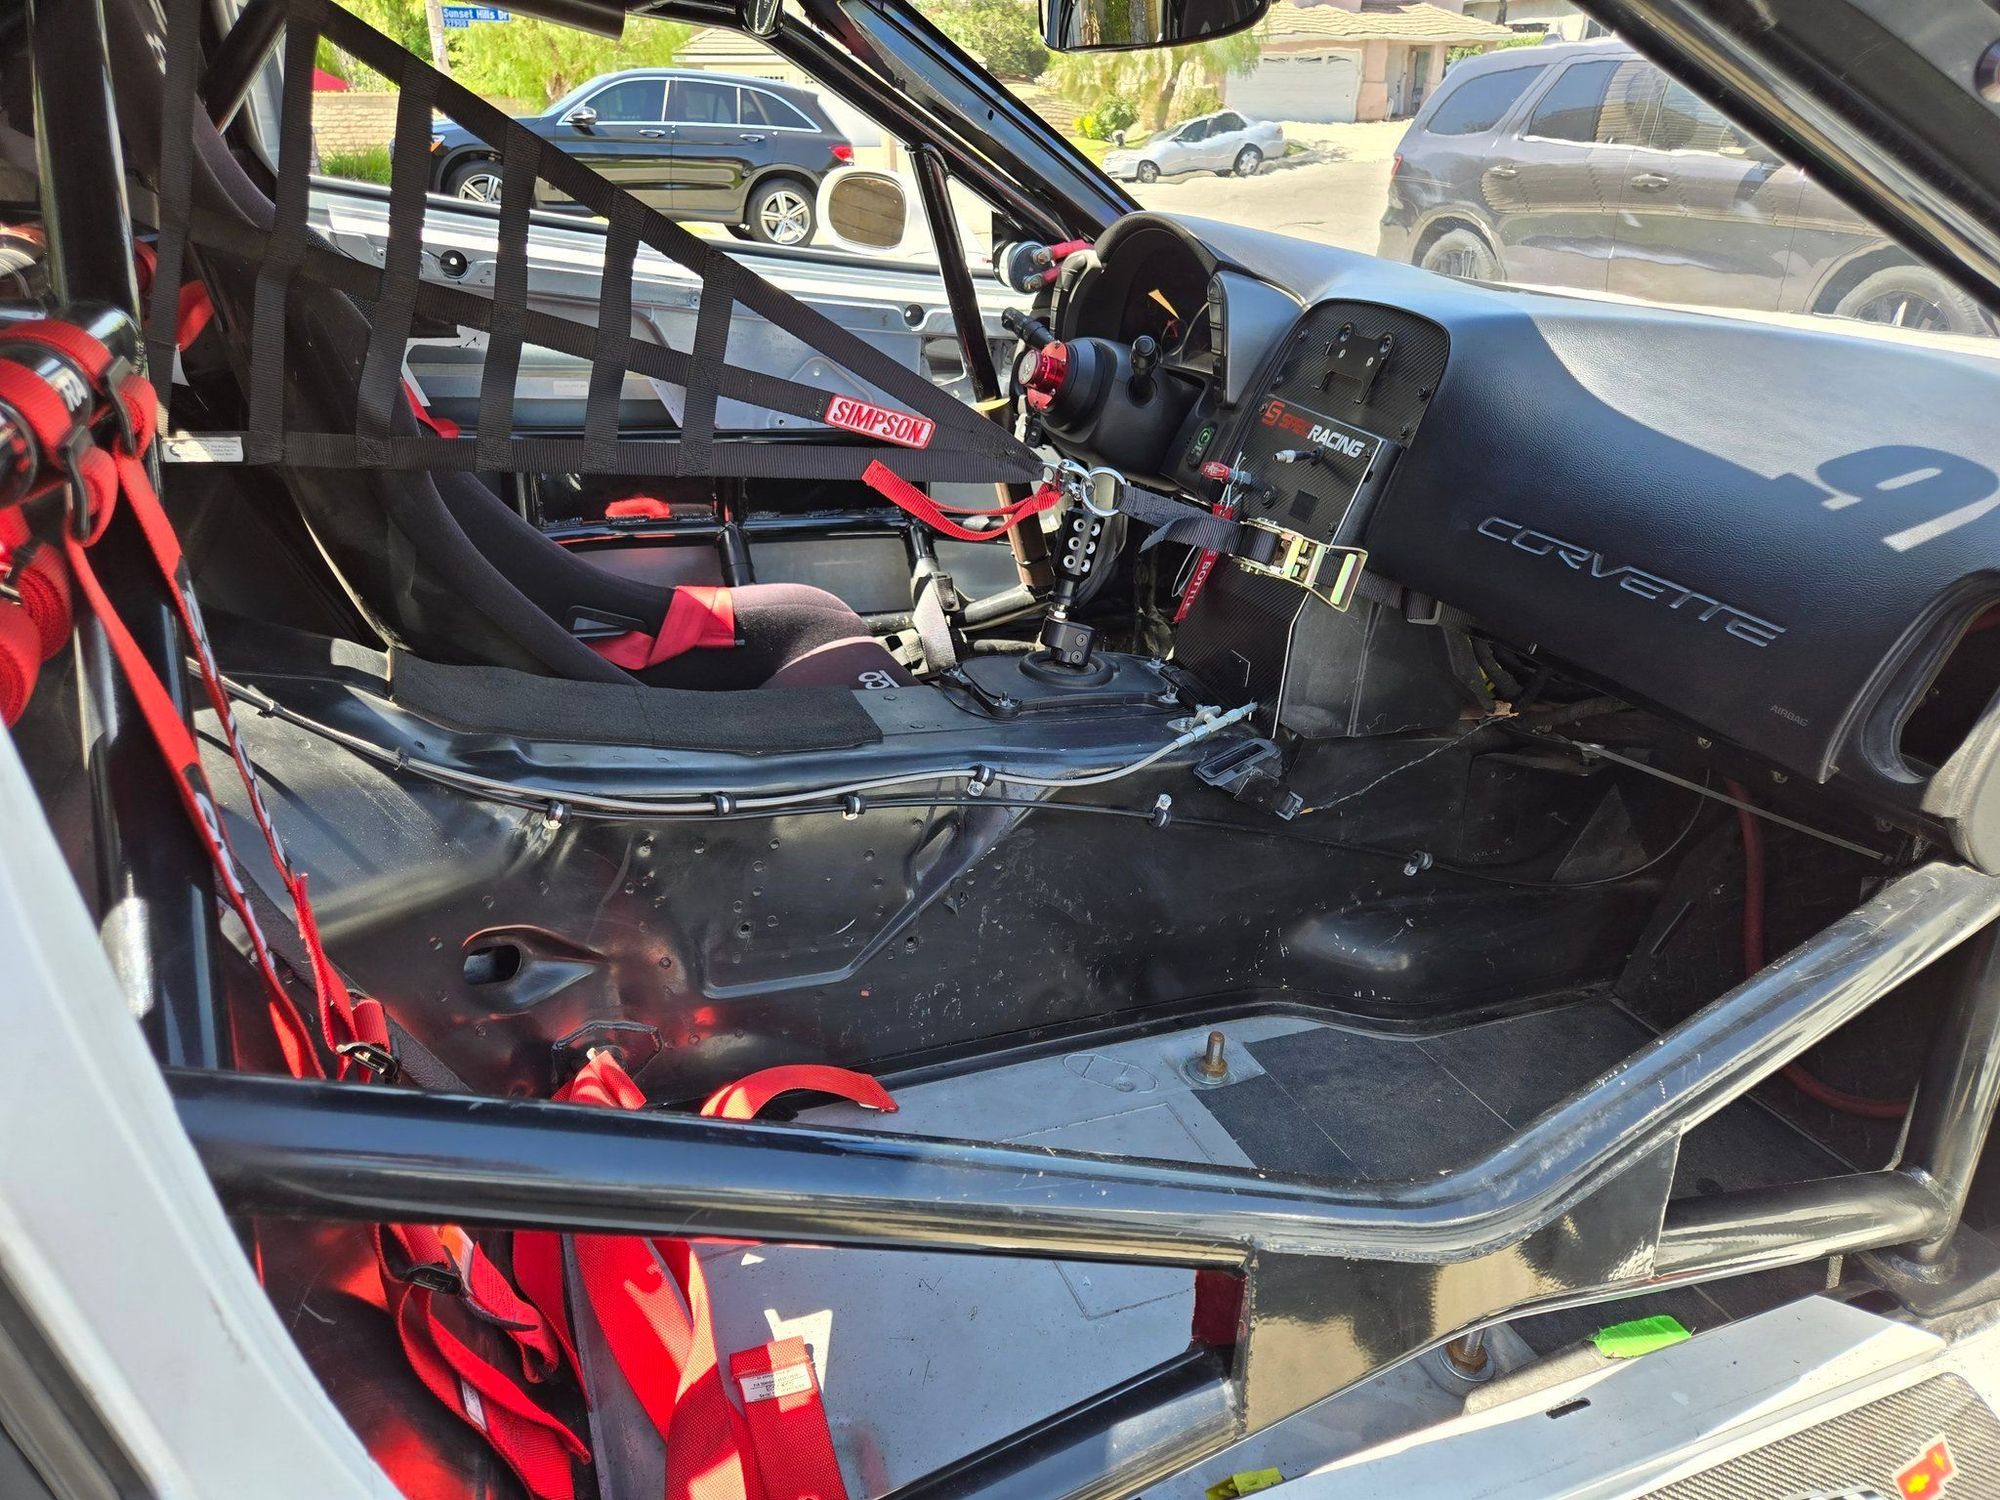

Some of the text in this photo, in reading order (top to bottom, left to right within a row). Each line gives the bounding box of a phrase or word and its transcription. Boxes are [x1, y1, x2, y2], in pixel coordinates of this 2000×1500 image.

[443, 8, 508, 20] Sunset Hills Dr
[833, 401, 926, 444] SIMPSON
[1478, 516, 1787, 648] CORVETTE
[1769, 704, 1809, 727] AIRBAG
